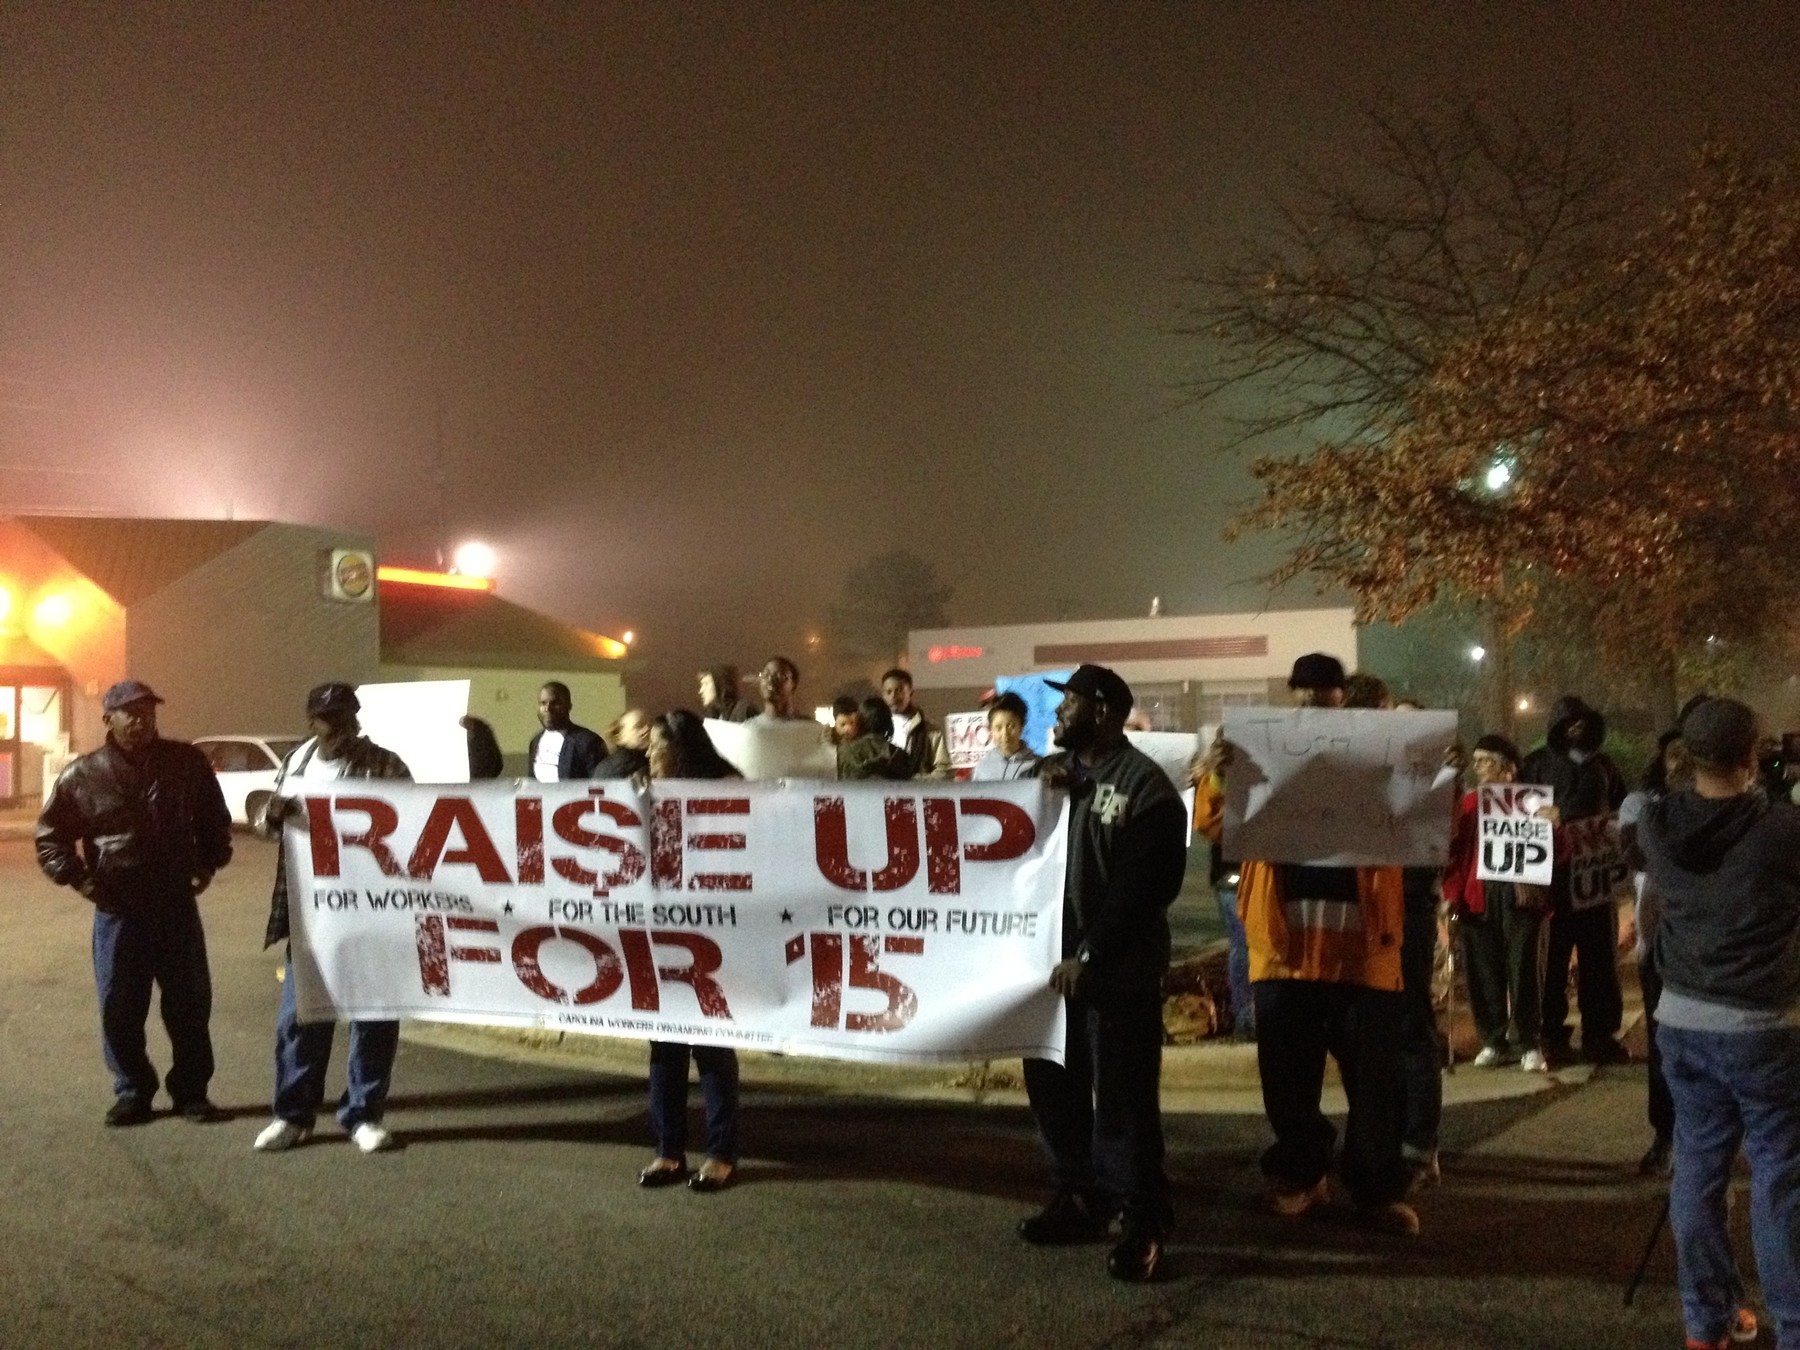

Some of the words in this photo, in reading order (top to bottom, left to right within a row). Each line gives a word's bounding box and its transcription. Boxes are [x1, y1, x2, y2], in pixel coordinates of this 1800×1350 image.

[1482, 786, 1548, 817] NC
[813, 796, 1036, 895] UP
[1483, 840, 1547, 876] UP
[1573, 863, 1629, 901] UP
[314, 888, 359, 912] FOR
[366, 888, 474, 913] WORKERS
[548, 898, 594, 922] FOR
[600, 901, 646, 925] THE
[652, 903, 737, 928] SOUTH
[827, 904, 880, 930] FOR
[887, 906, 939, 933] OUR
[945, 908, 1038, 939] FUTURE
[415, 914, 733, 1022] FOR
[558, 1012, 604, 1028] CAROLINA
[608, 1016, 655, 1032] WORKERS
